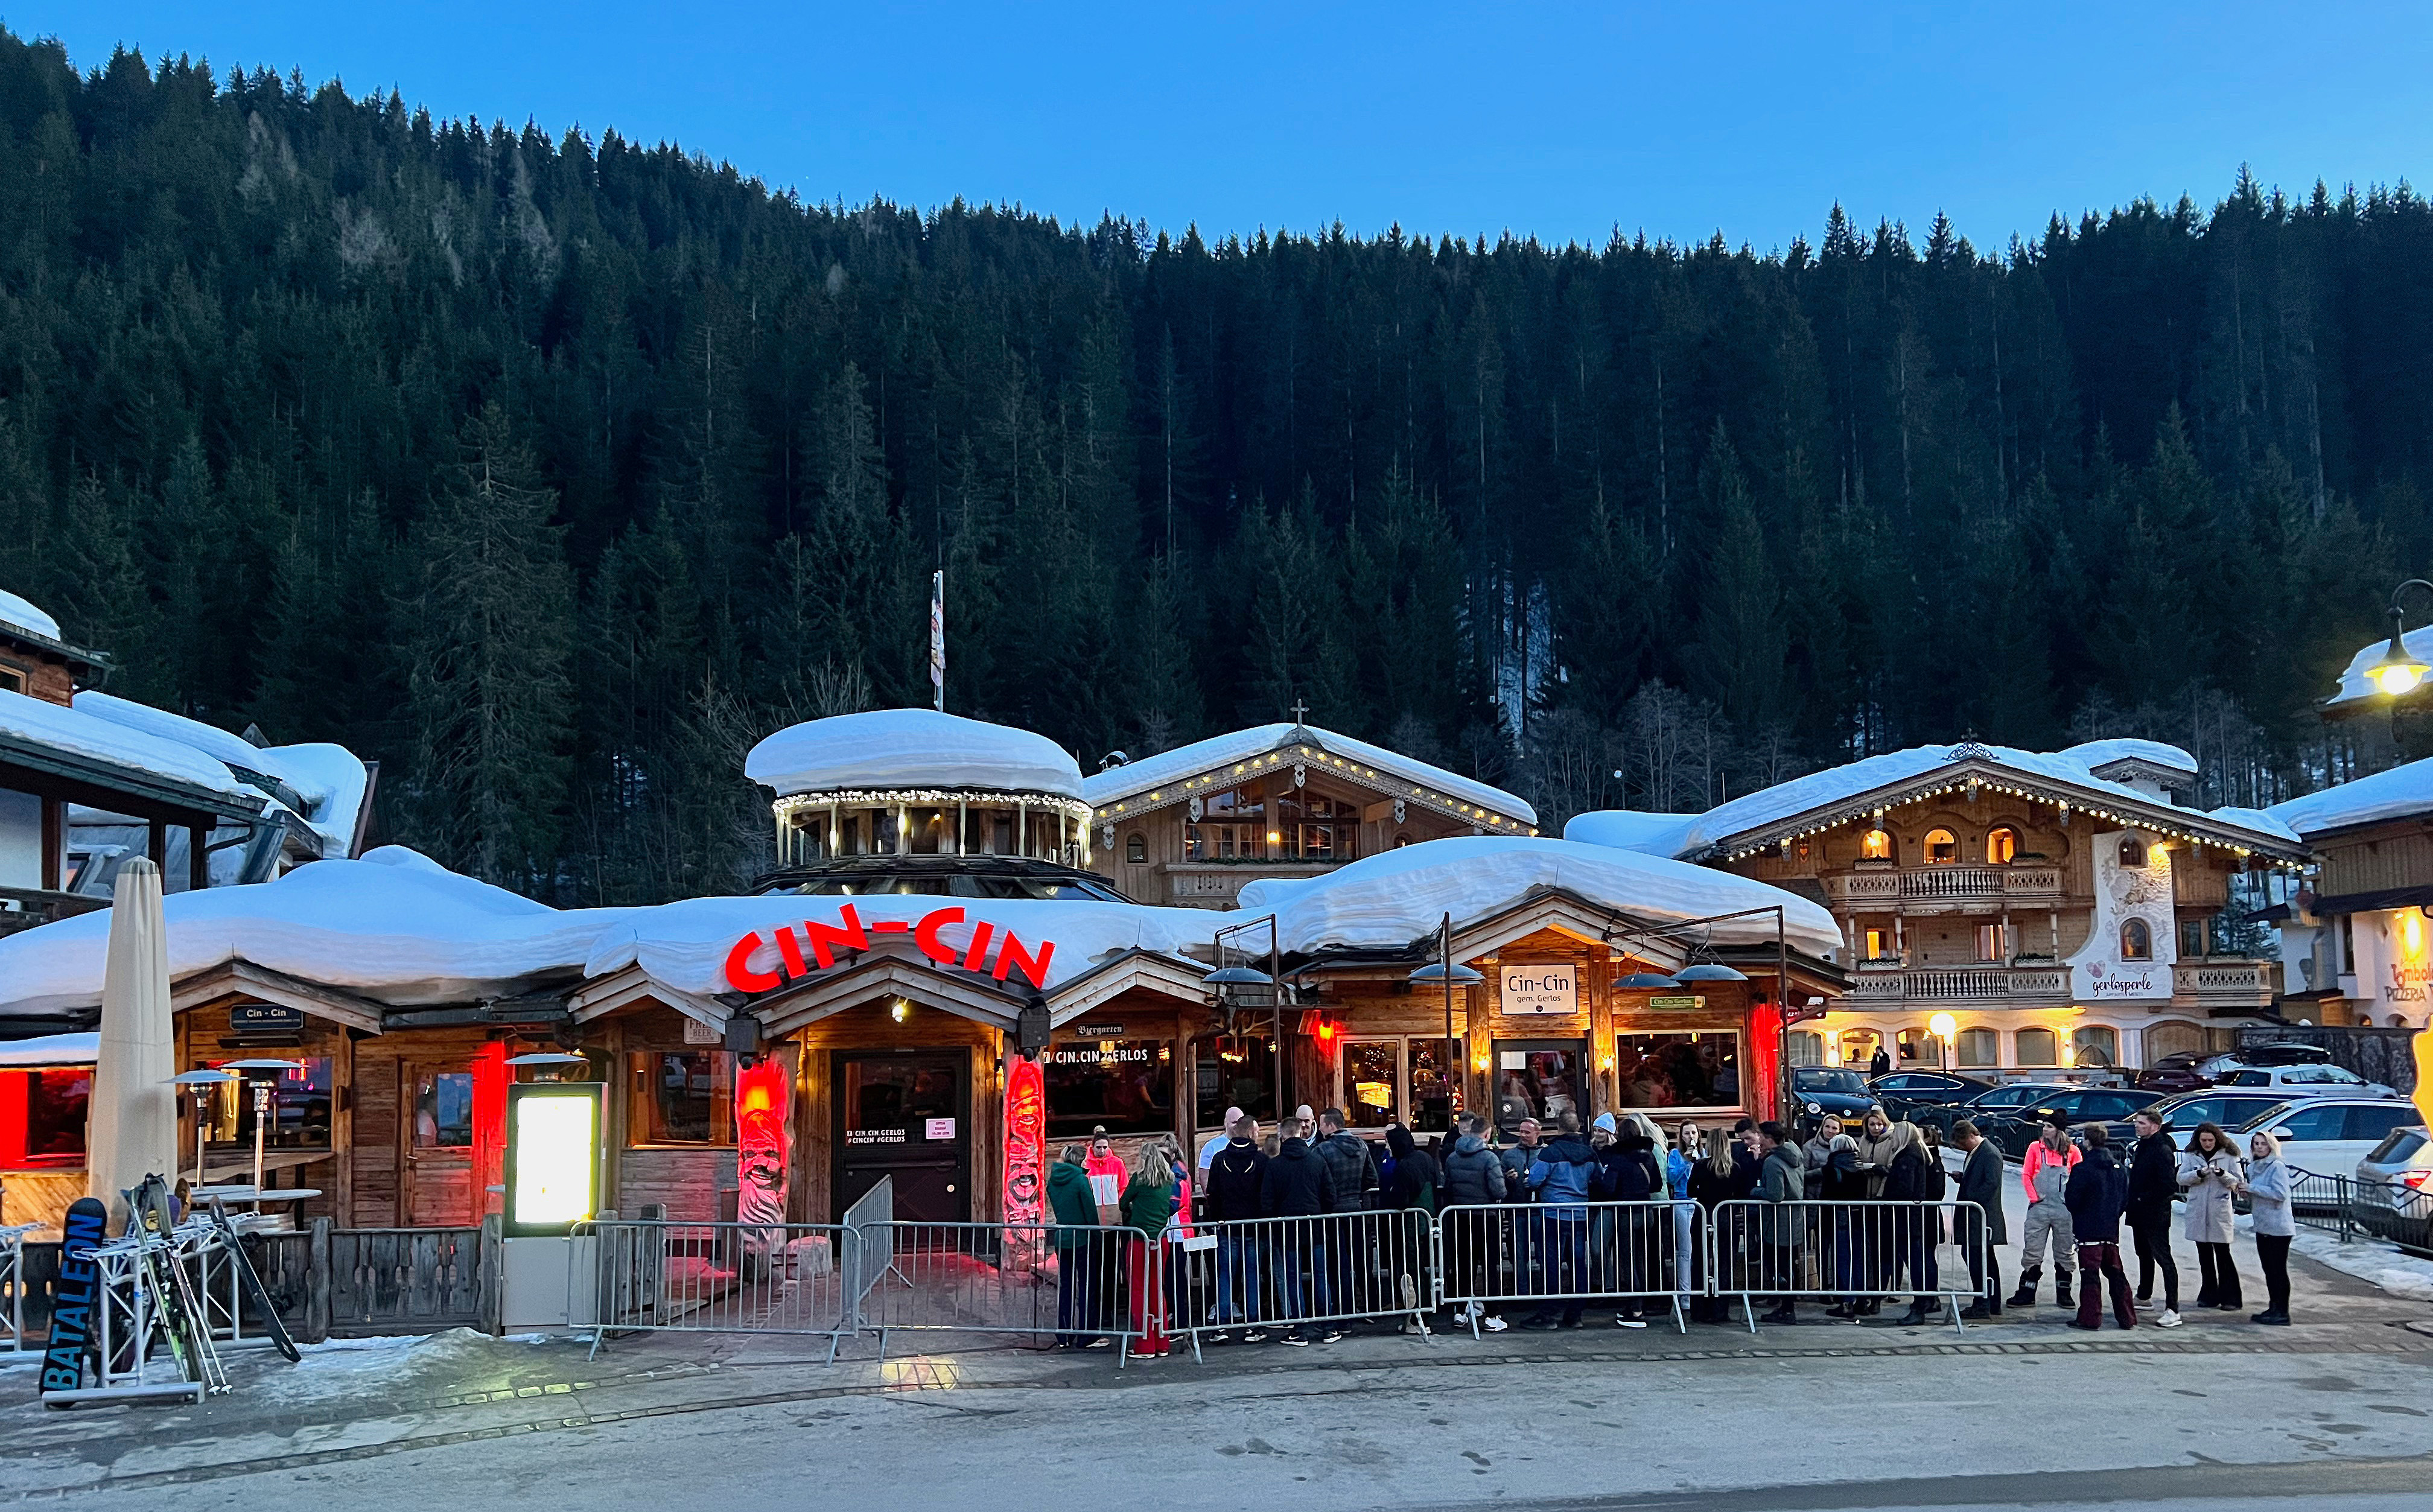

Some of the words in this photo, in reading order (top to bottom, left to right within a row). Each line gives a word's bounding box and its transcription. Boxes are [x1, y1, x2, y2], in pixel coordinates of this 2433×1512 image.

[725, 903, 1056, 993] CIN-CIN
[1509, 974, 1569, 991] Cin-Cin
[2093, 972, 2153, 997] gerlosperle
[2384, 986, 2426, 1002] PIZZERIA
[1078, 1025, 1122, 1035] Biergarten
[43, 1213, 103, 1391] BATALEON
